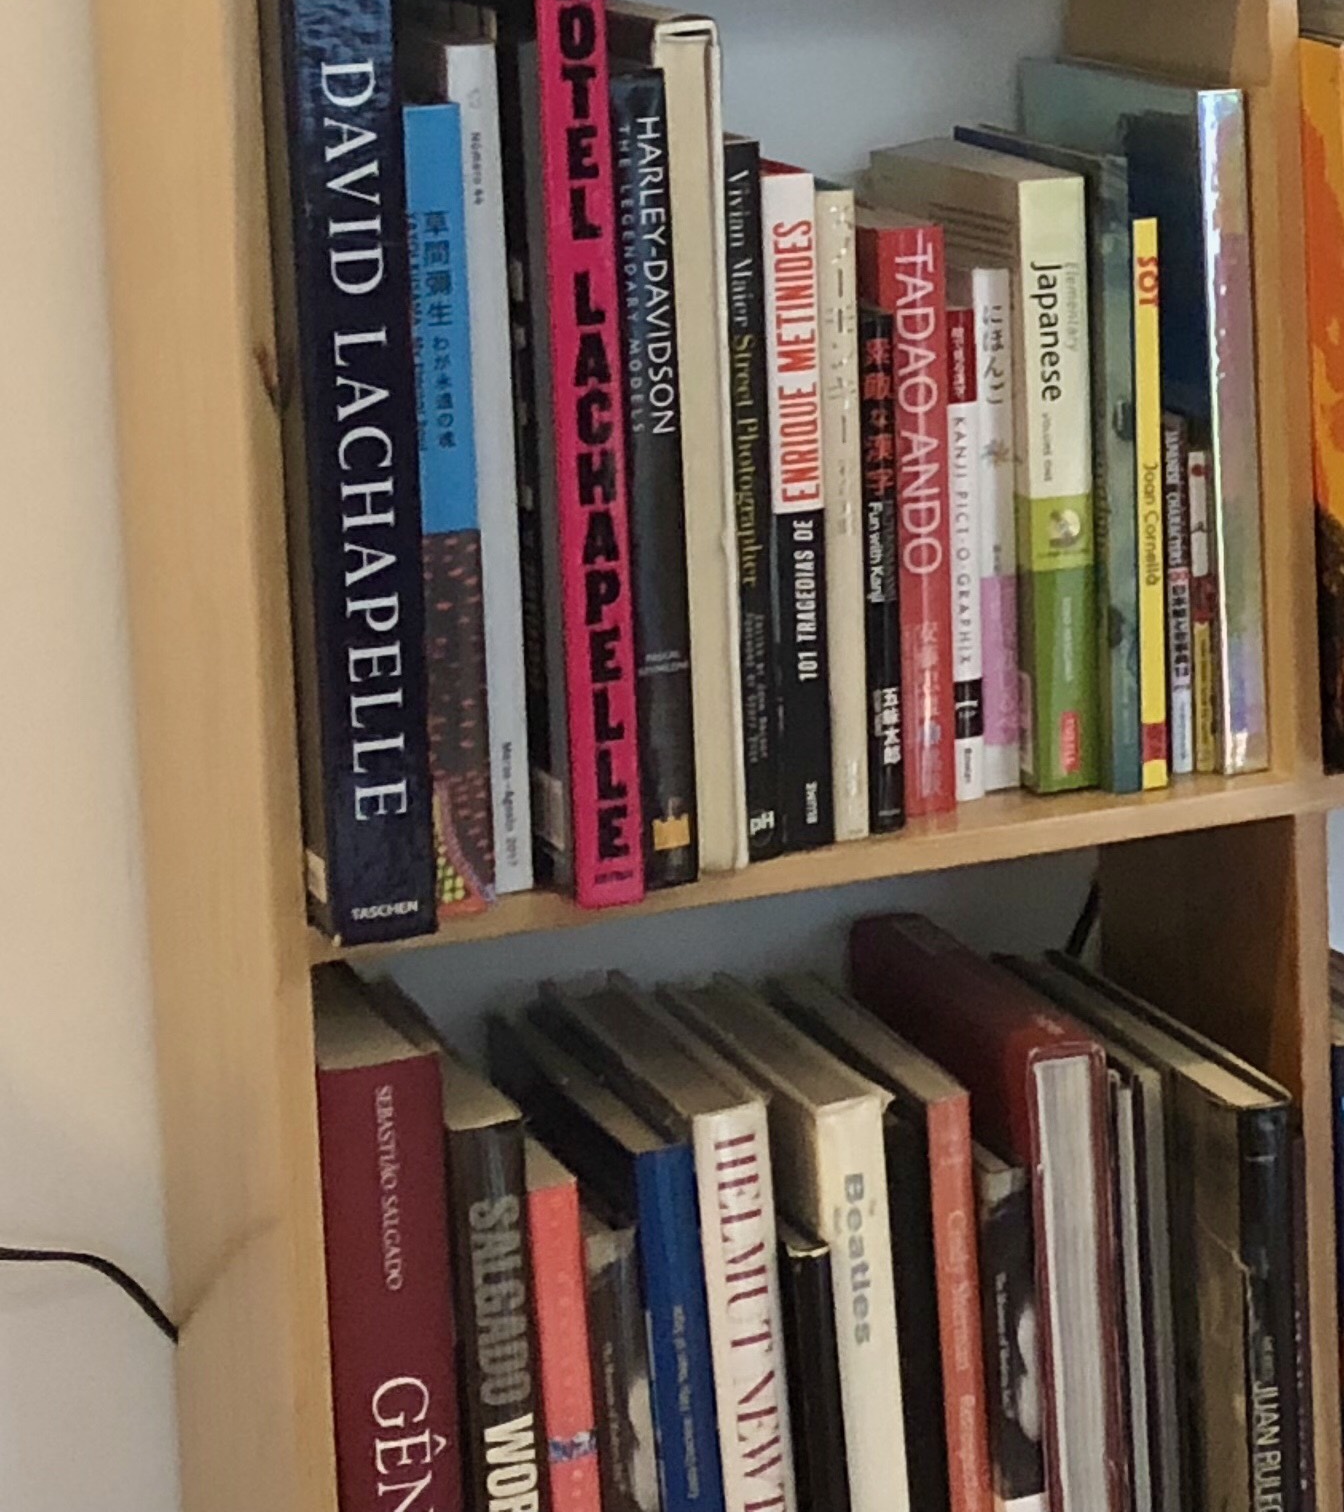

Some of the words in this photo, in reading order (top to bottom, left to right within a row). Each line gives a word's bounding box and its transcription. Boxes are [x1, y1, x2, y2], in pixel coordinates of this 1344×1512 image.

[320, 59, 384, 296] DAVID
[617, 124, 632, 167] THE
[620, 184, 642, 323] LEGENDARY
[725, 169, 750, 248] Vivian
[635, 115, 676, 435] HARLEY-DAVIDSON
[730, 257, 754, 328] Maier
[772, 220, 816, 374] METINIDES
[1063, 260, 1081, 351] Elementary
[1138, 255, 1159, 308] SOT
[733, 333, 757, 407] Street
[893, 241, 937, 414] TADAO
[1030, 260, 1065, 402] Japanese
[628, 337, 646, 434] MODELS
[778, 387, 820, 502] ENRIQUE
[952, 416, 967, 478] KANJI
[1143, 462, 1159, 506] Joan
[736, 418, 764, 588] Photographer
[793, 518, 814, 542] DE
[867, 501, 883, 531] Fun
[868, 532, 883, 564] with
[900, 431, 944, 574] ANDO
[332, 325, 408, 821] LACHAPELLE
[574, 272, 631, 862] LACHAPELLE
[794, 549, 818, 642] TRAGEDIAS
[868, 565, 884, 603] Kanji
[799, 650, 819, 682] 101
[350, 899, 419, 921] TASCHEN
[374, 1084, 400, 1188] SEBASTIÃO
[379, 1194, 403, 1290] SALGADO
[714, 1134, 774, 1353] HELMUT
[843, 1172, 874, 1346] Beatles
[467, 1194, 532, 1407] SALGADO
[1253, 1380, 1280, 1445] JUAN
